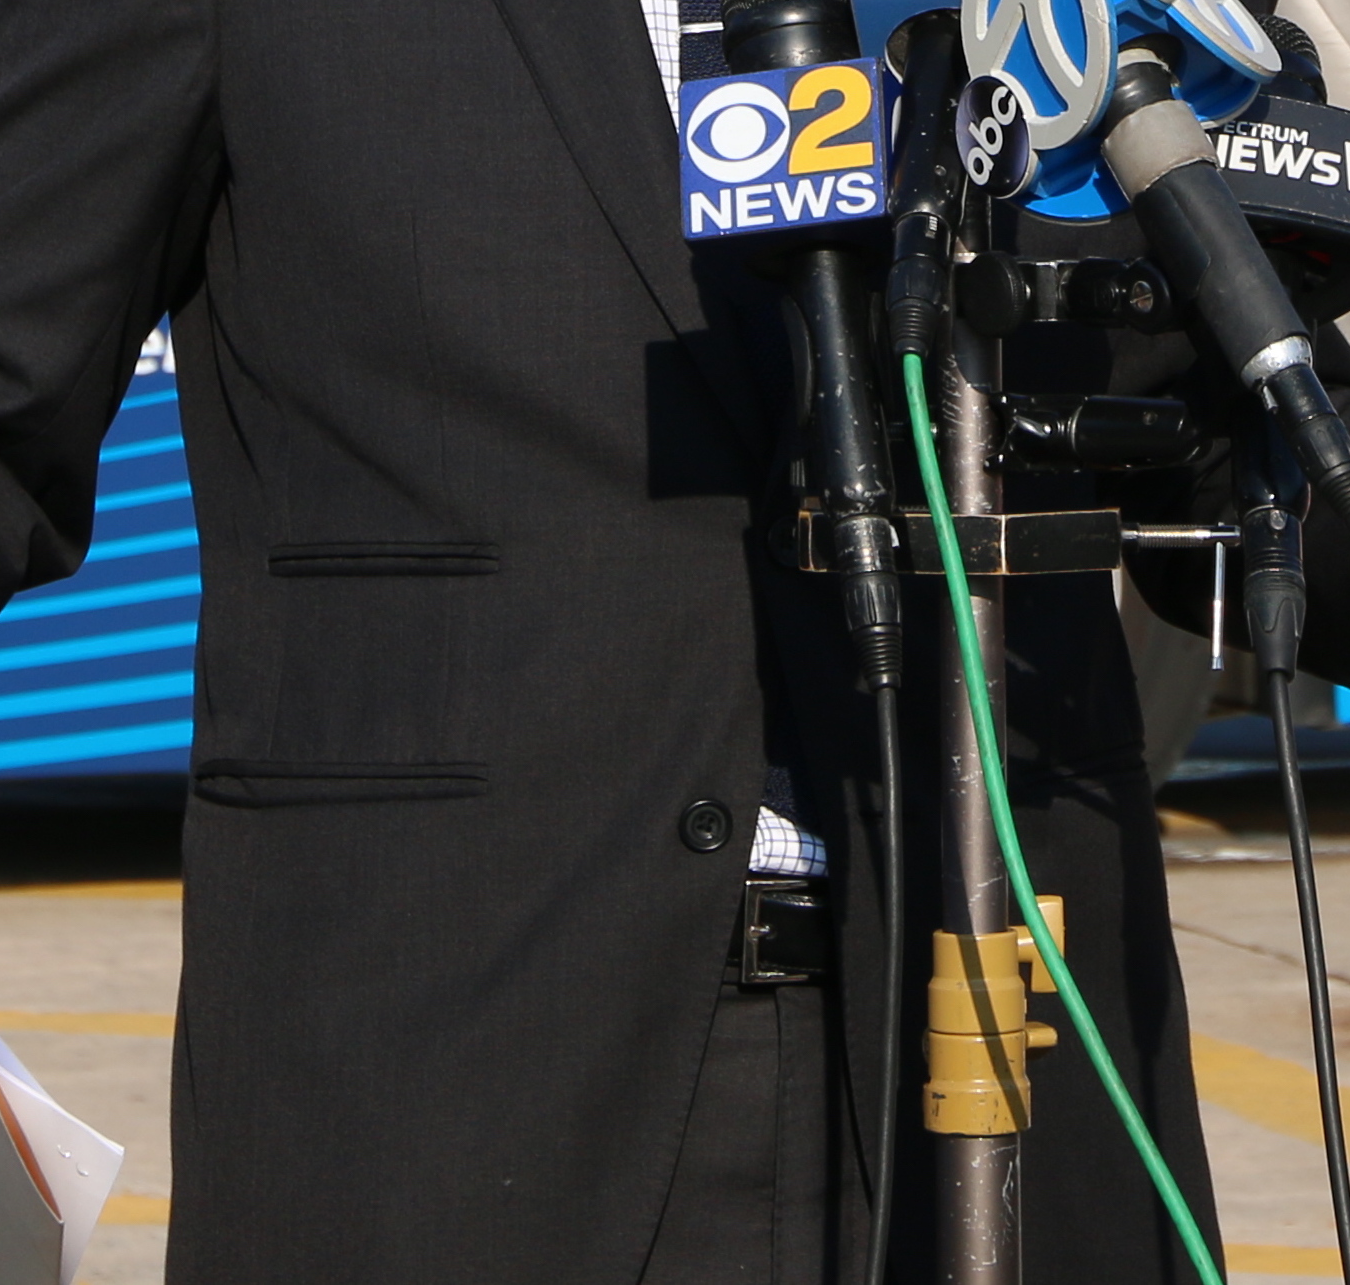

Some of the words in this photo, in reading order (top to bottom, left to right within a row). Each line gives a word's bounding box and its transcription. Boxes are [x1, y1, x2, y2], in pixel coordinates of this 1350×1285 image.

[788, 65, 874, 175] 2
[966, 86, 1018, 186] abc
[690, 171, 877, 233] NEWS
